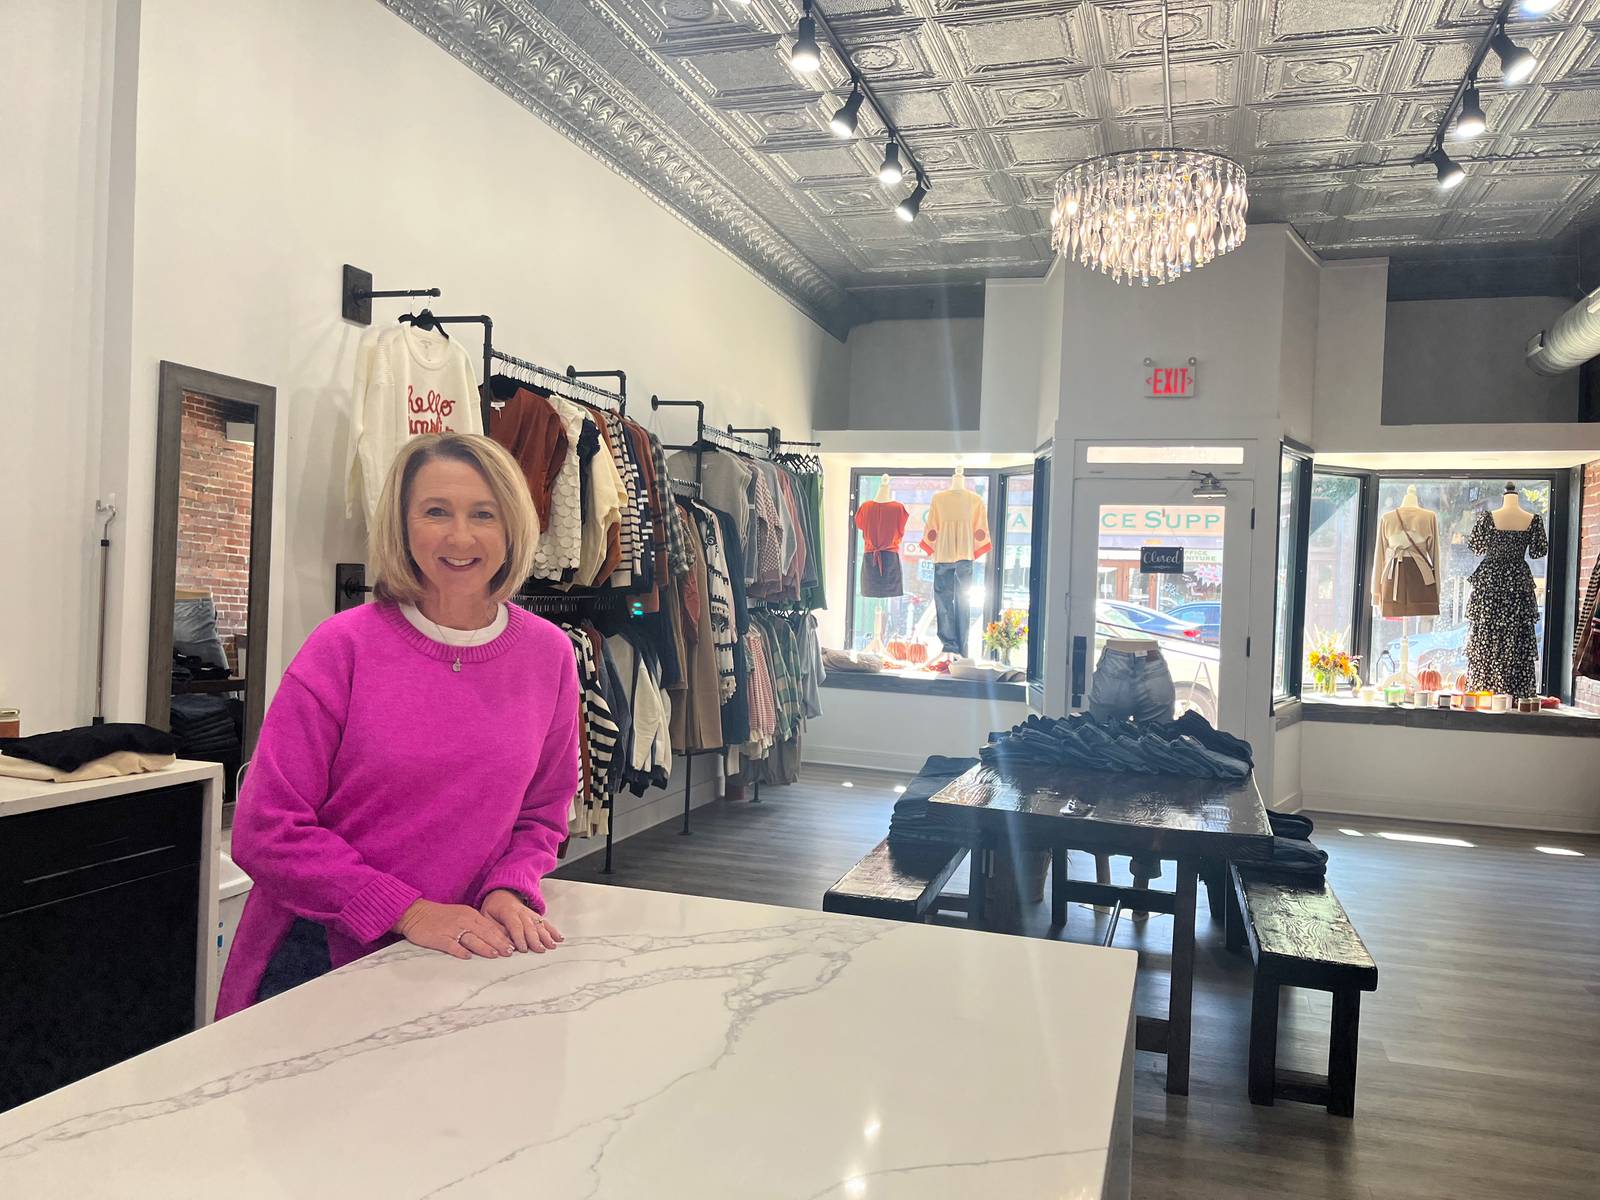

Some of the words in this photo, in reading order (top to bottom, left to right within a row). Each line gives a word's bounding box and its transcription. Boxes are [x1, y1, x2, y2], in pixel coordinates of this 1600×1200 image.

[1153, 367, 1188, 395] EXIT
[408, 385, 456, 417] hello
[1143, 551, 1181, 564] Closed
